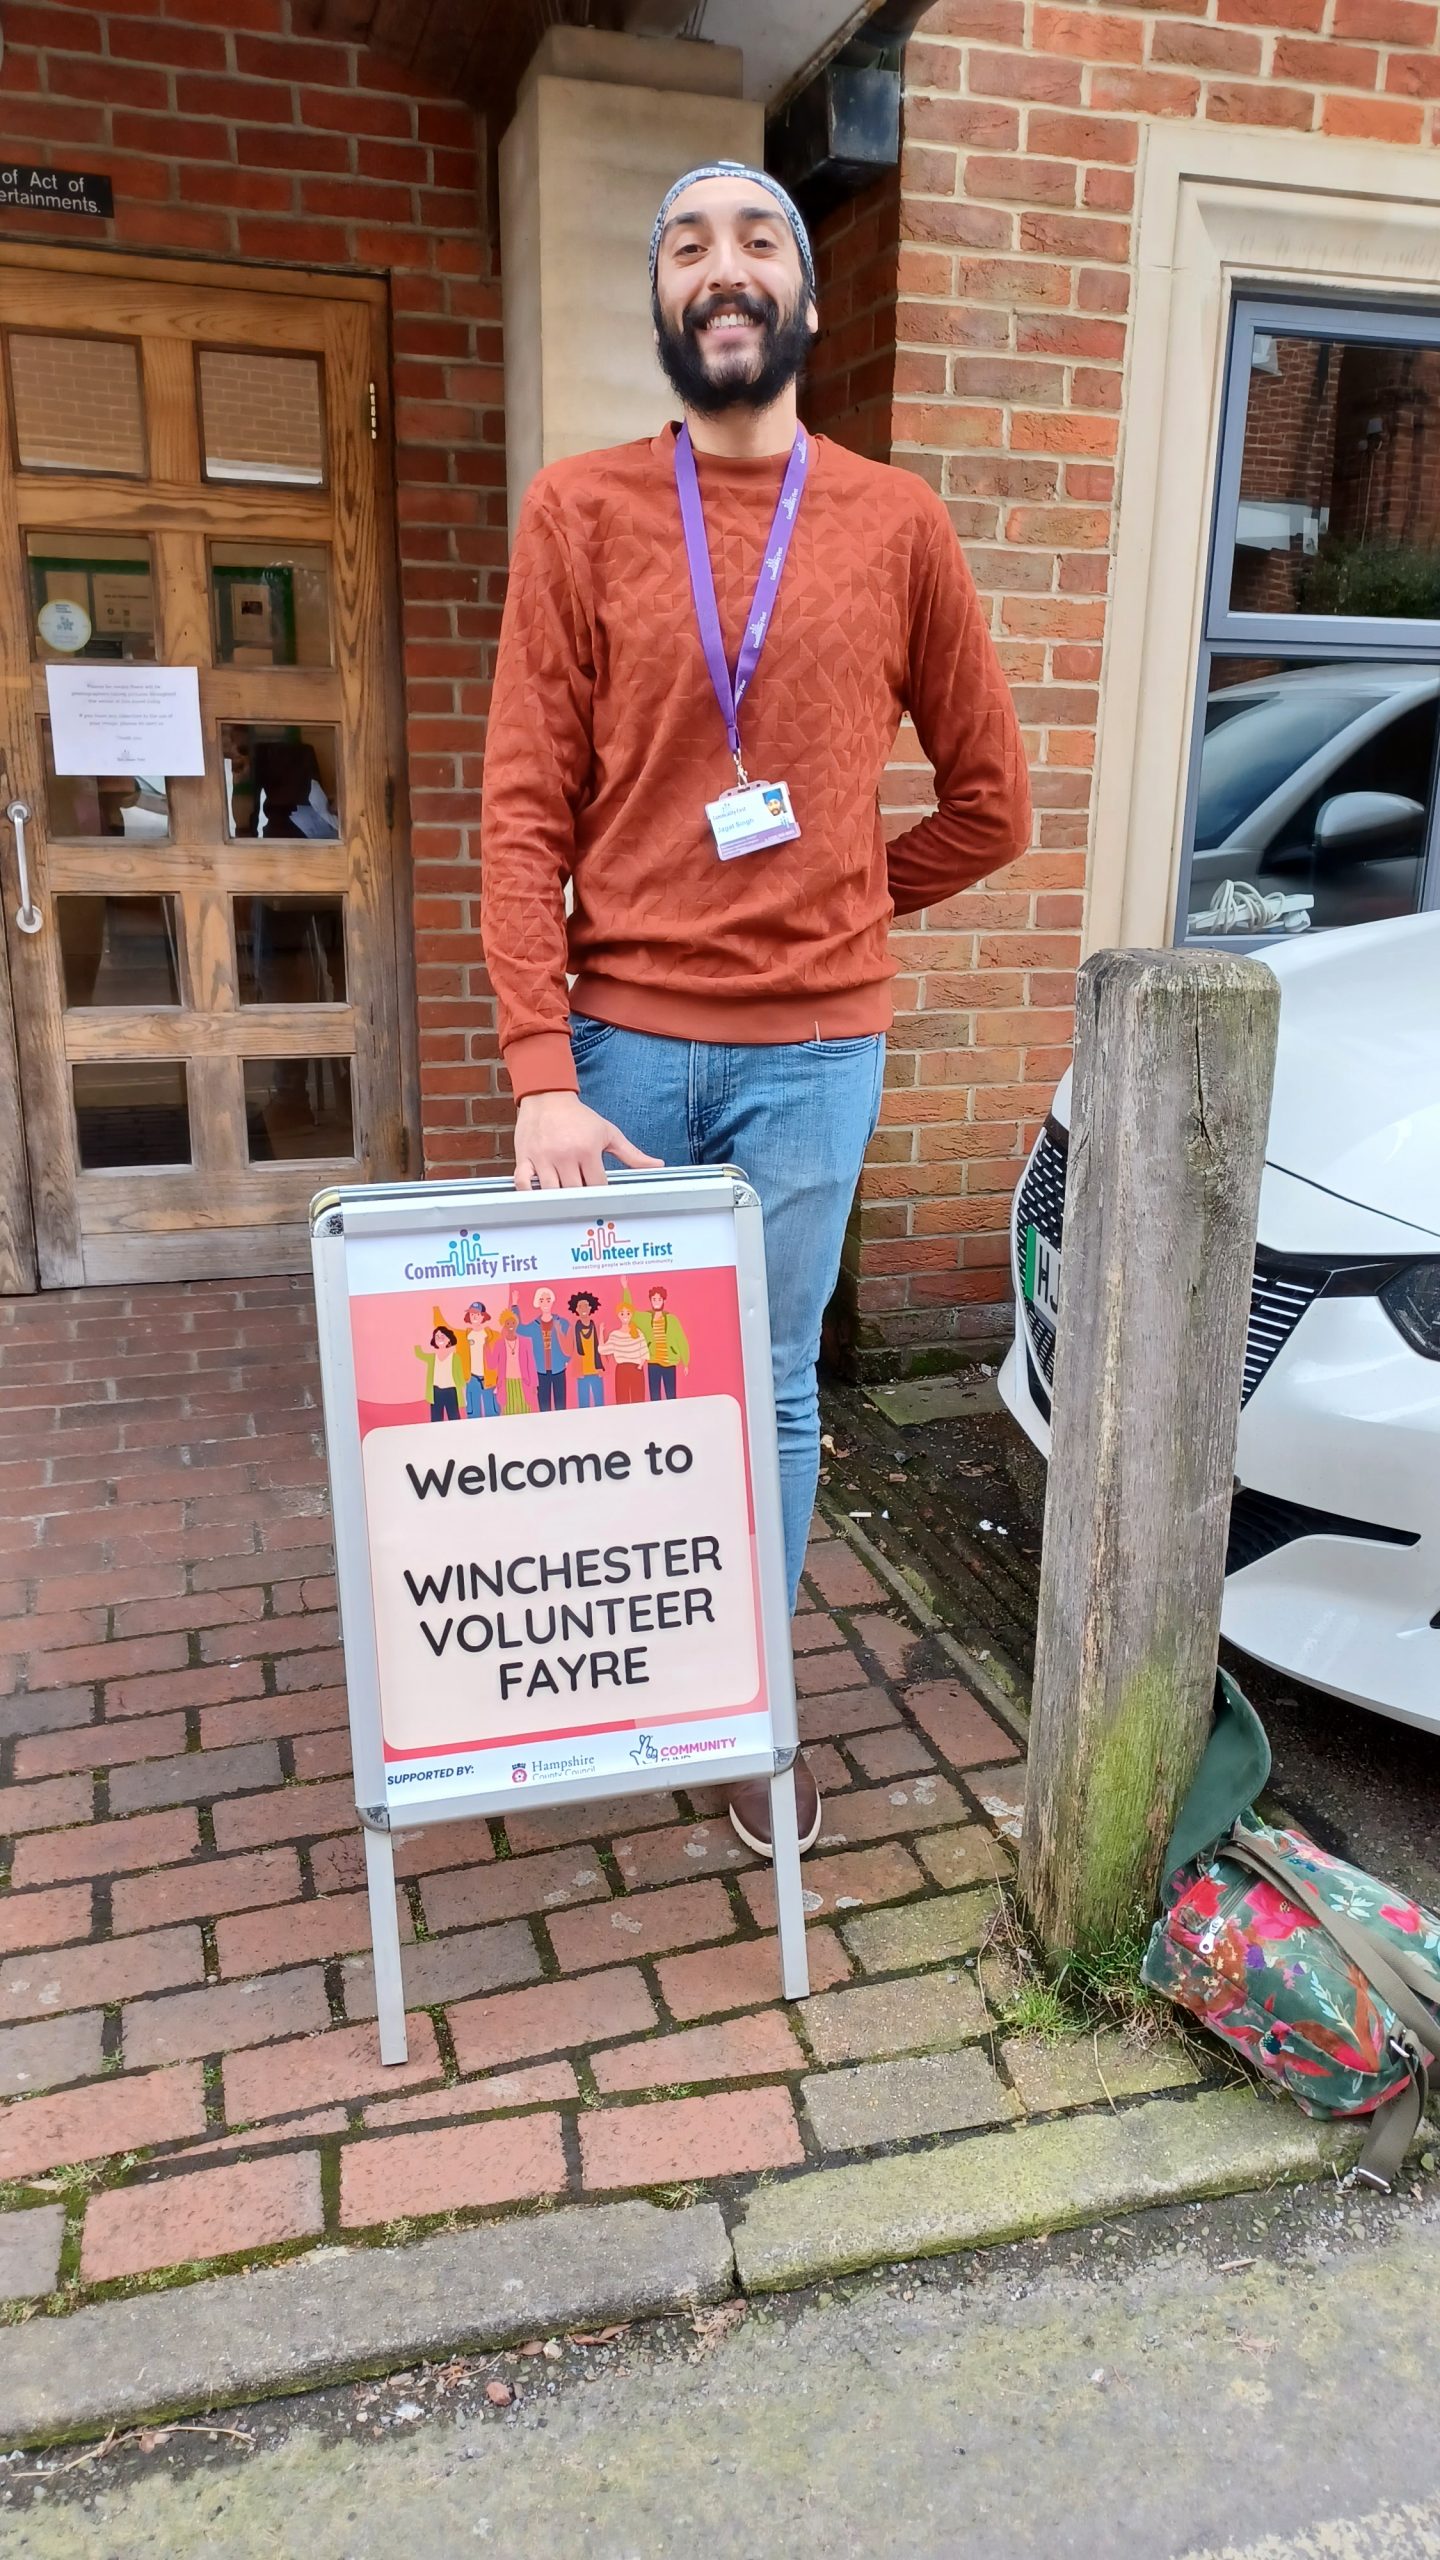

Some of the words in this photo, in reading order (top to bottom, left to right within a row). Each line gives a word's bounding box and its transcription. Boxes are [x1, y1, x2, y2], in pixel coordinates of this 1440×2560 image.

[1, 168, 18, 185] of
[29, 171, 58, 190] Act
[68, 177, 85, 193] of
[643, 1242, 673, 1257] First
[502, 1254, 538, 1273] First
[405, 1452, 631, 1501] Welcome
[643, 1441, 694, 1476] to
[402, 1535, 724, 1607] WINCHESTER
[419, 1587, 716, 1657] VOLUNTEER
[499, 1646, 650, 1701] FAYRE
[660, 1737, 737, 1757] COMMUNITY
[532, 1754, 595, 1772] Hampshire
[387, 1767, 454, 1786] SUPPORTED
[456, 1764, 475, 1776] BY:
